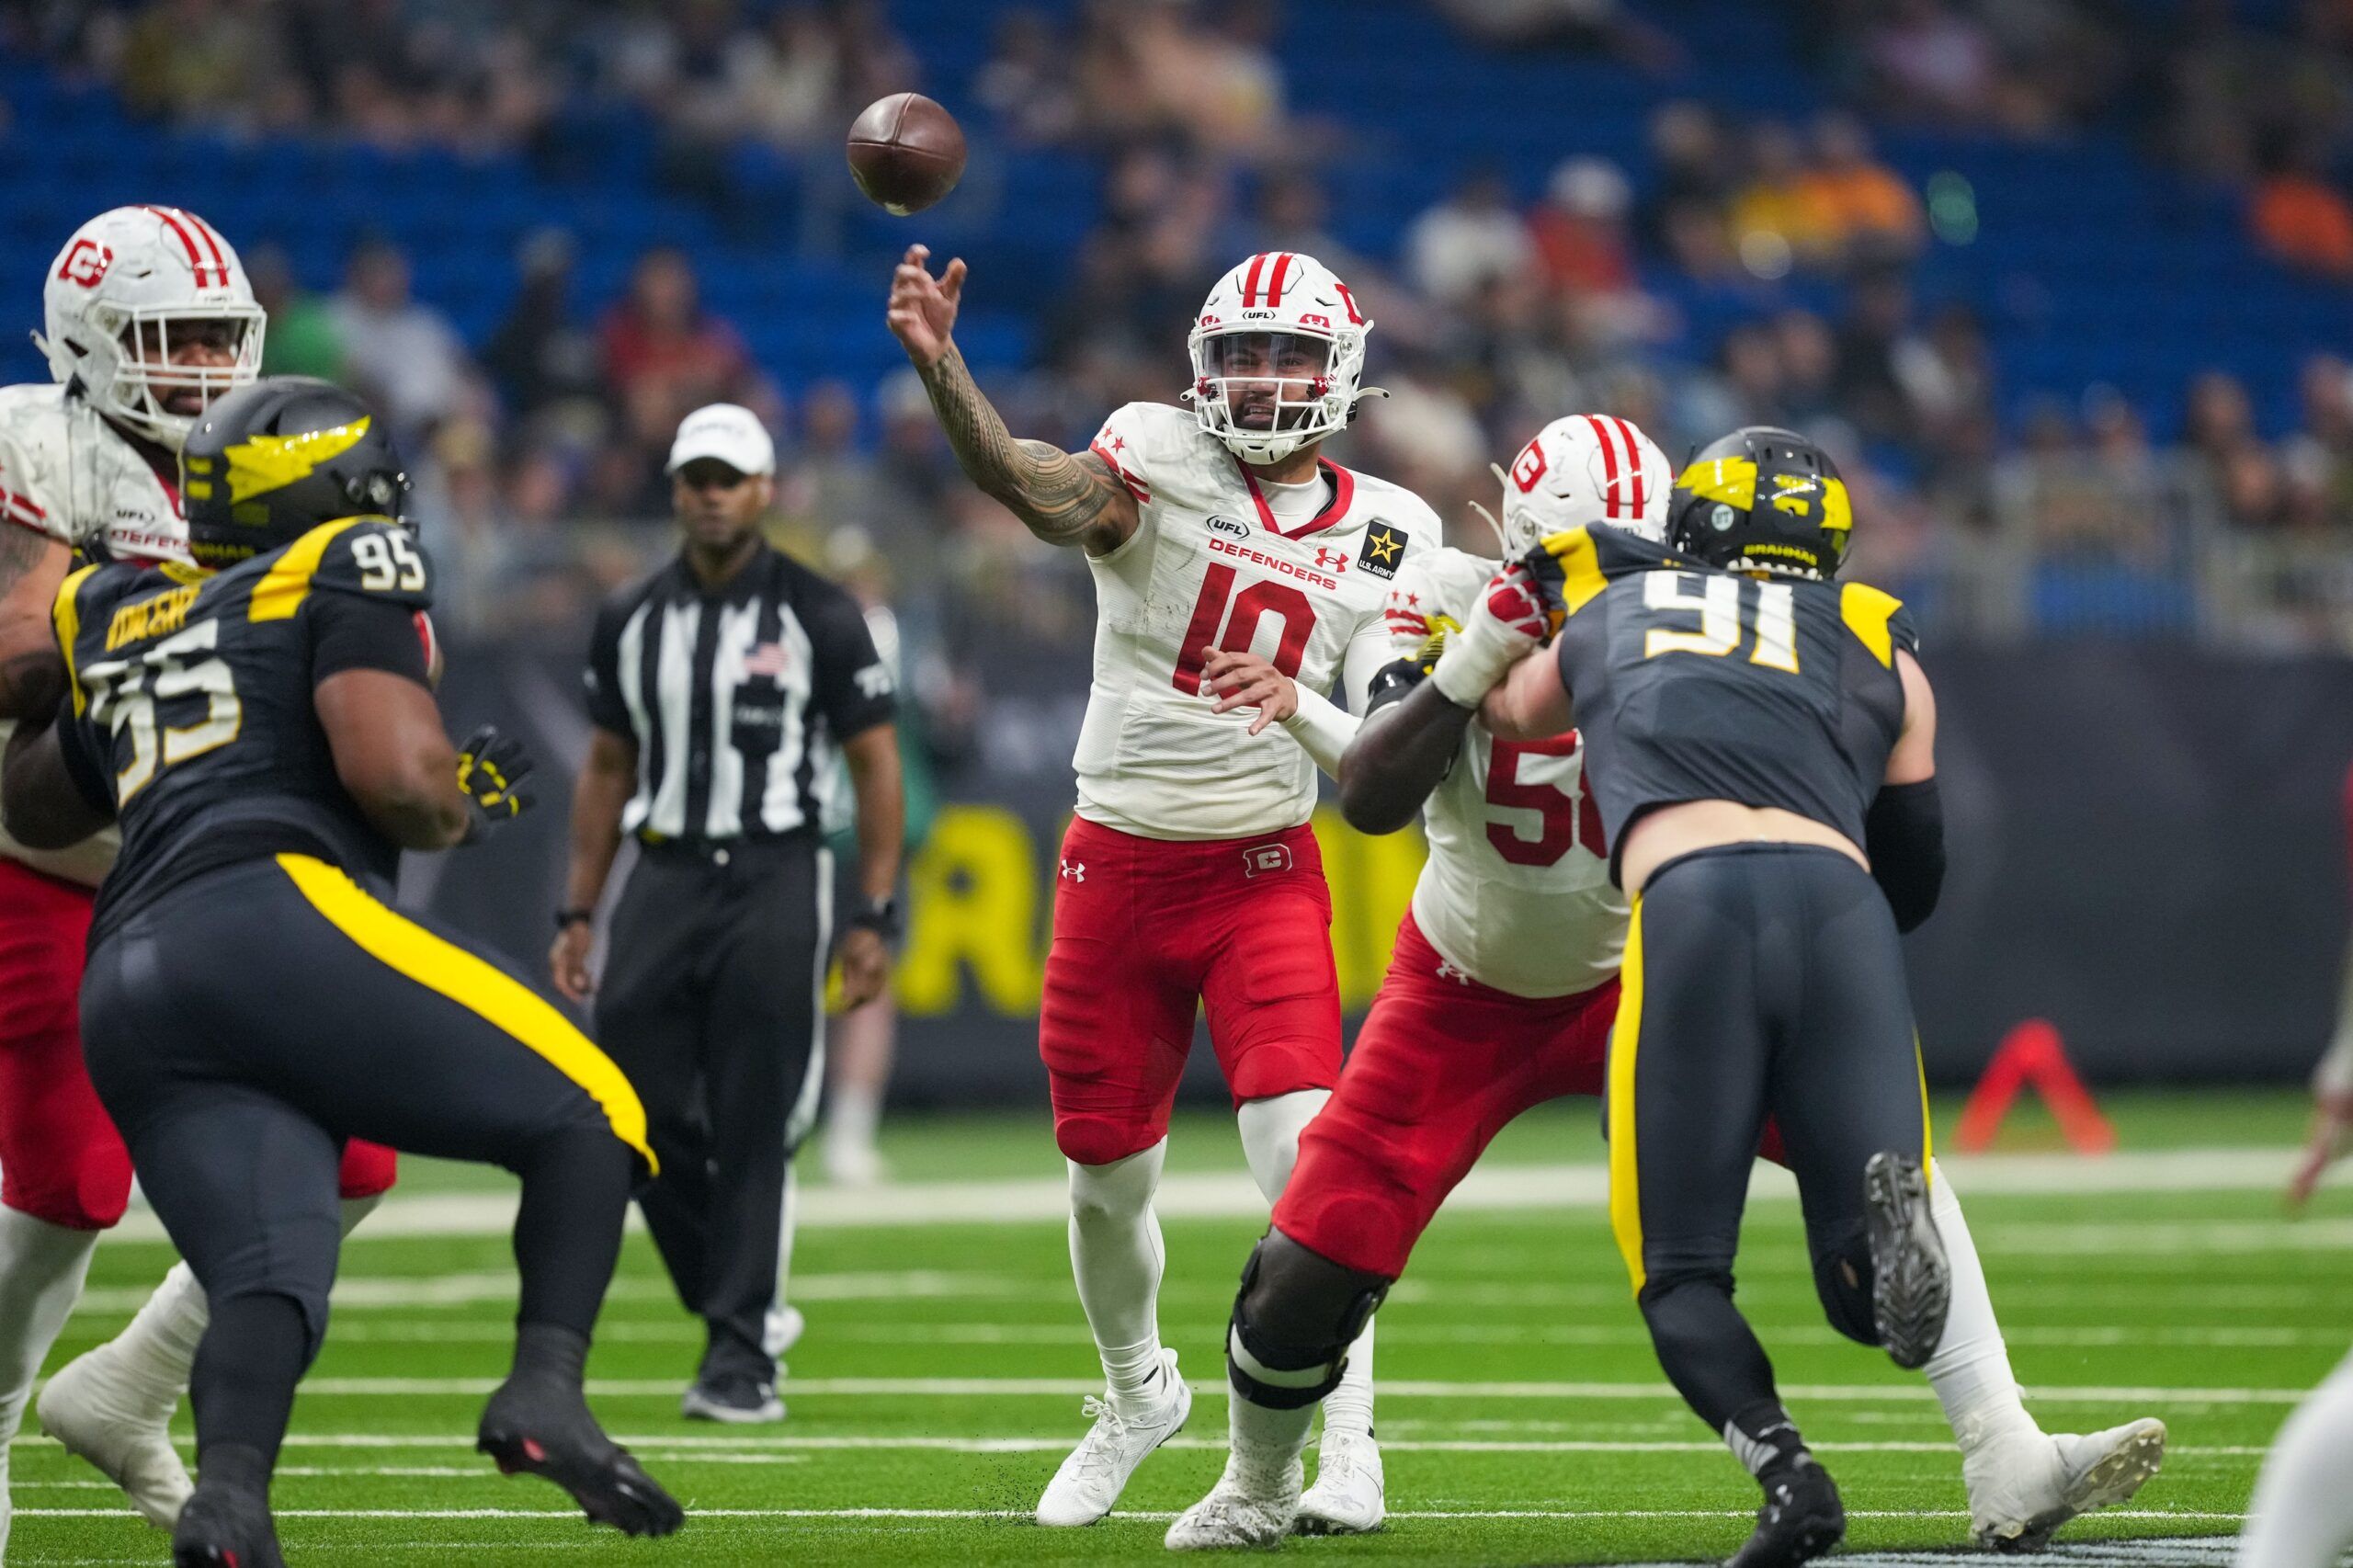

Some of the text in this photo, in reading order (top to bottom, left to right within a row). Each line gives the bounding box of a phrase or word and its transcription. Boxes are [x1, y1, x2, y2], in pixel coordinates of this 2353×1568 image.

[1213, 519, 1243, 535] UFL
[351, 529, 426, 591] 95
[1209, 539, 1337, 591] DEFENDERS
[1358, 560, 1395, 579] U.S. ARMY
[1172, 562, 1317, 709] 10
[1643, 570, 1800, 675] 91
[80, 618, 242, 809] 95
